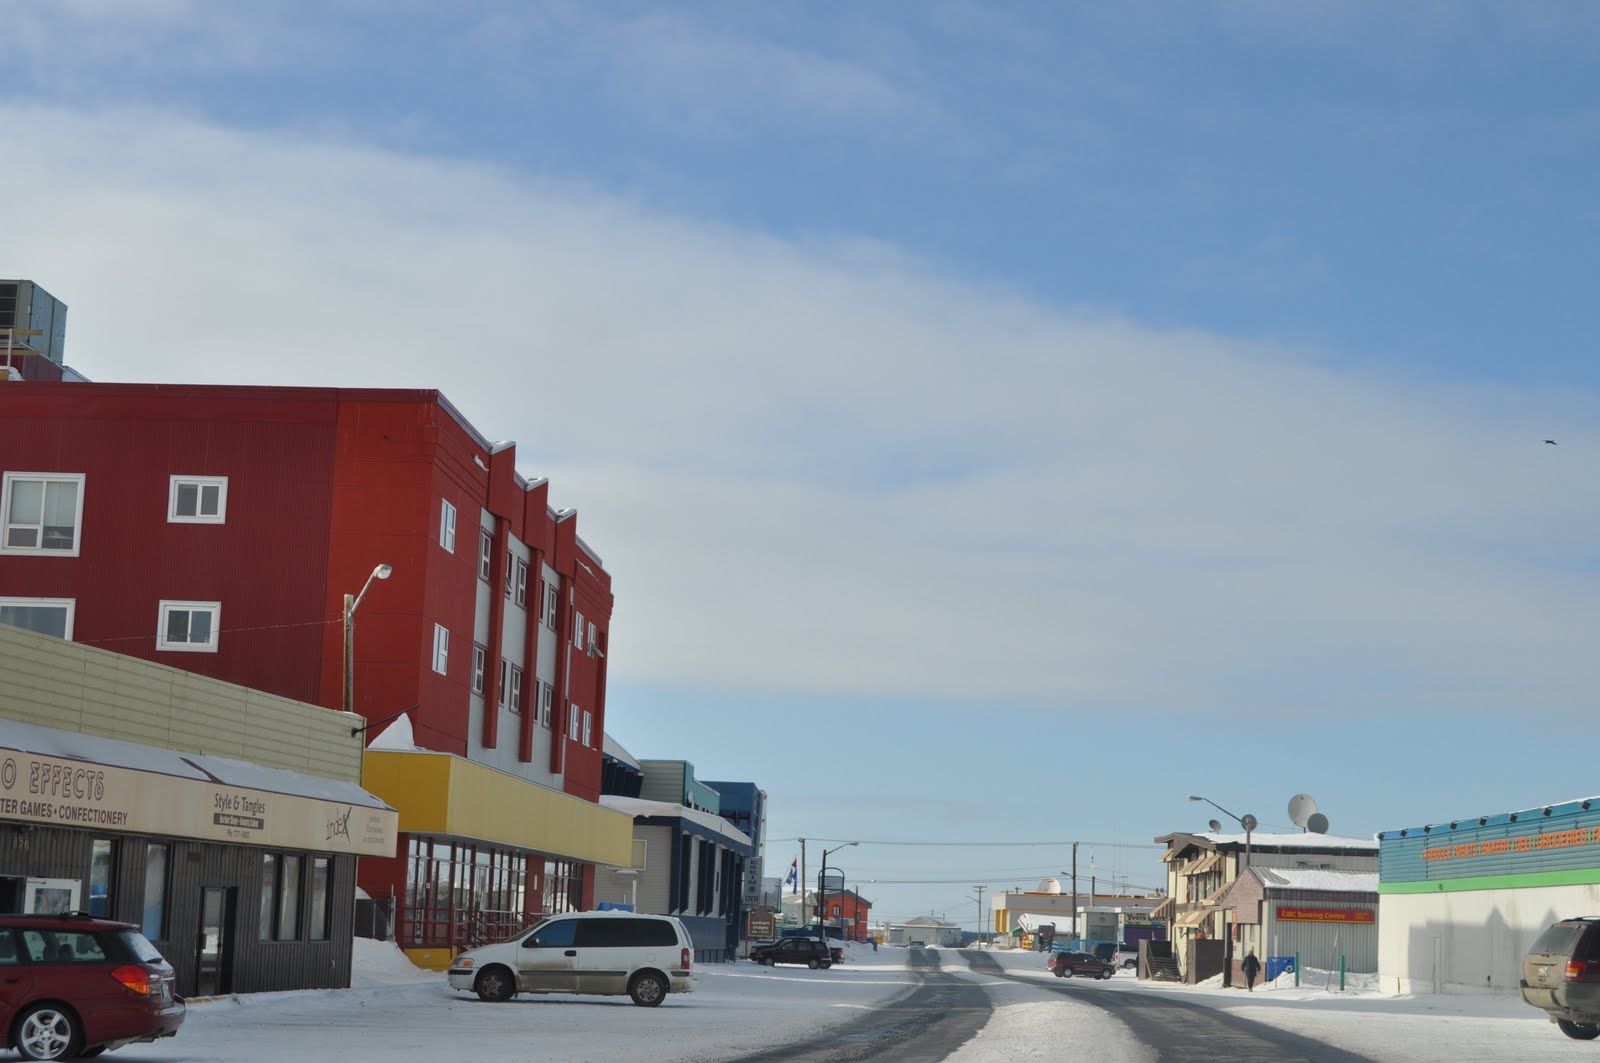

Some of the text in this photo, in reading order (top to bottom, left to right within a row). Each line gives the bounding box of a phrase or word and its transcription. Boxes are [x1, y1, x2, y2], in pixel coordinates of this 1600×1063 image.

[29, 761, 105, 801] EFFECTS
[20, 799, 53, 818] GAMES
[58, 804, 128, 826] CONFECTIONERY
[214, 792, 232, 812] Style
[241, 796, 265, 817] Tangles
[1537, 828, 1588, 849] GROCERIES
[1281, 910, 1297, 918] CIBC
[1298, 911, 1323, 920] Banking
[1324, 912, 1345, 920] Centre
